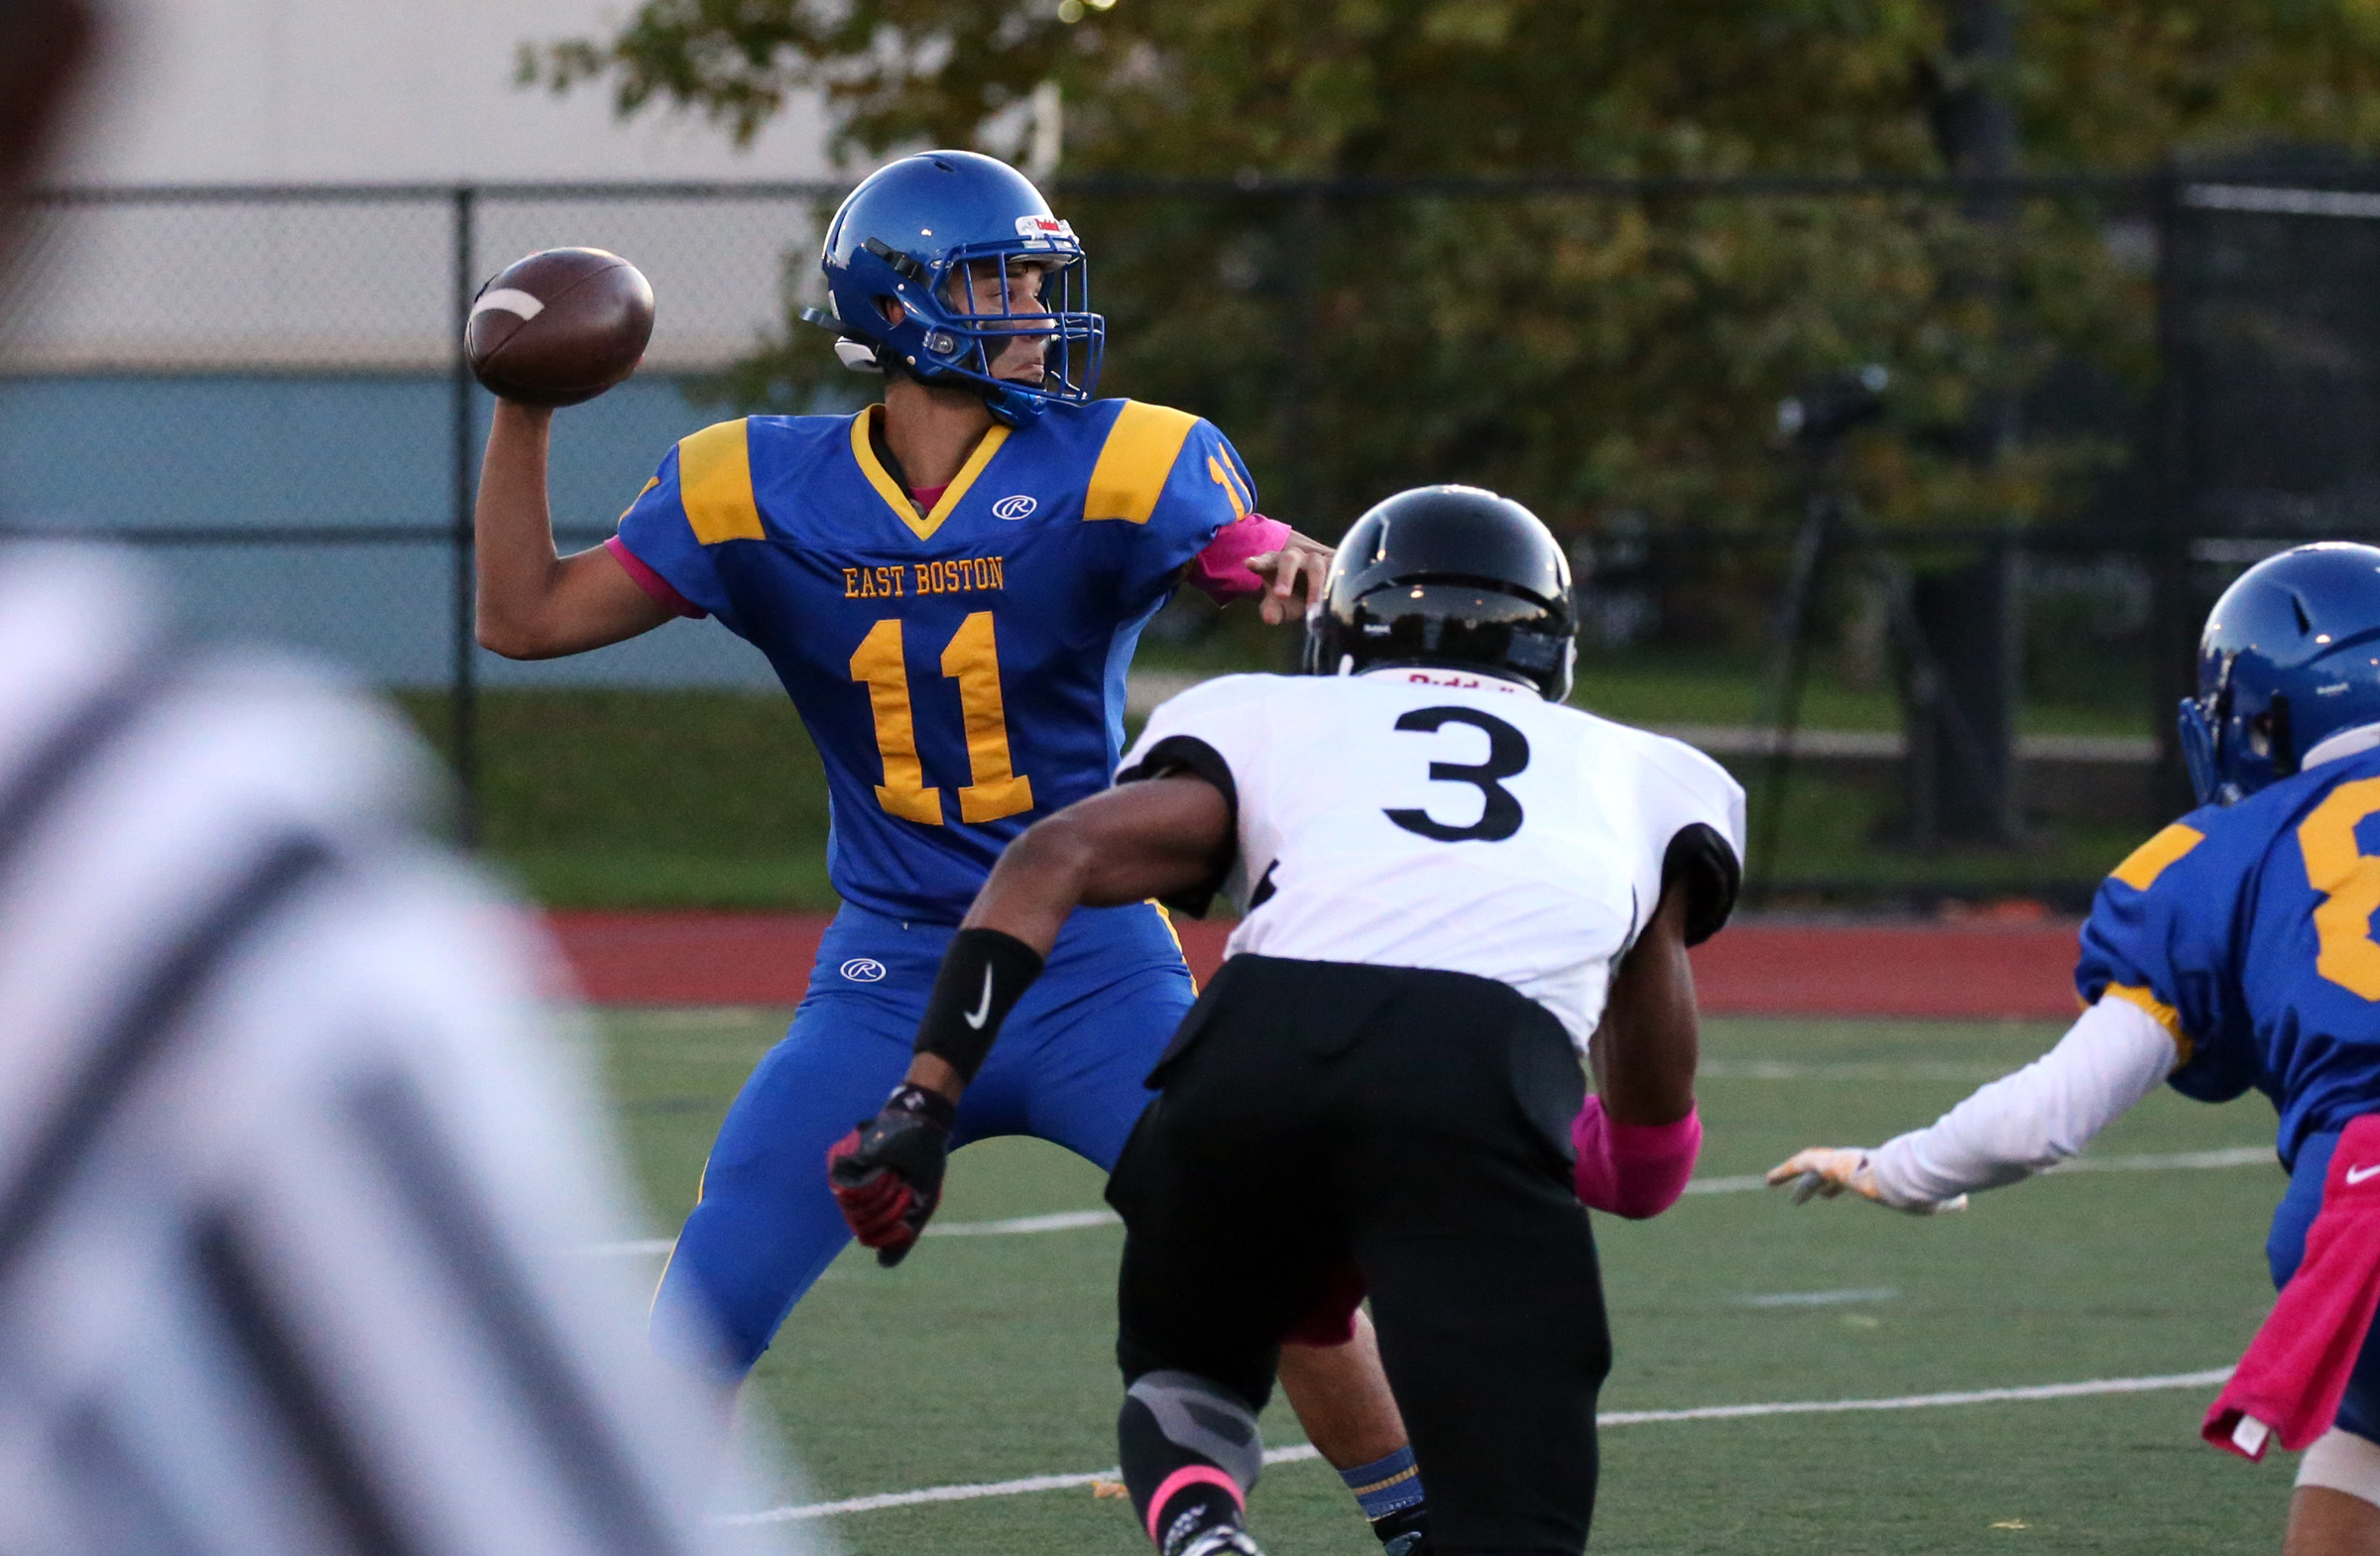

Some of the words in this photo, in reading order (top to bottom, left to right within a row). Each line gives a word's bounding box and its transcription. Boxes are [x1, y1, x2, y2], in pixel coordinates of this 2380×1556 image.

[843, 566, 904, 598] EAST
[914, 556, 1004, 595] BOSTON
[850, 610, 1034, 825] 11
[1381, 706, 1530, 843] 3
